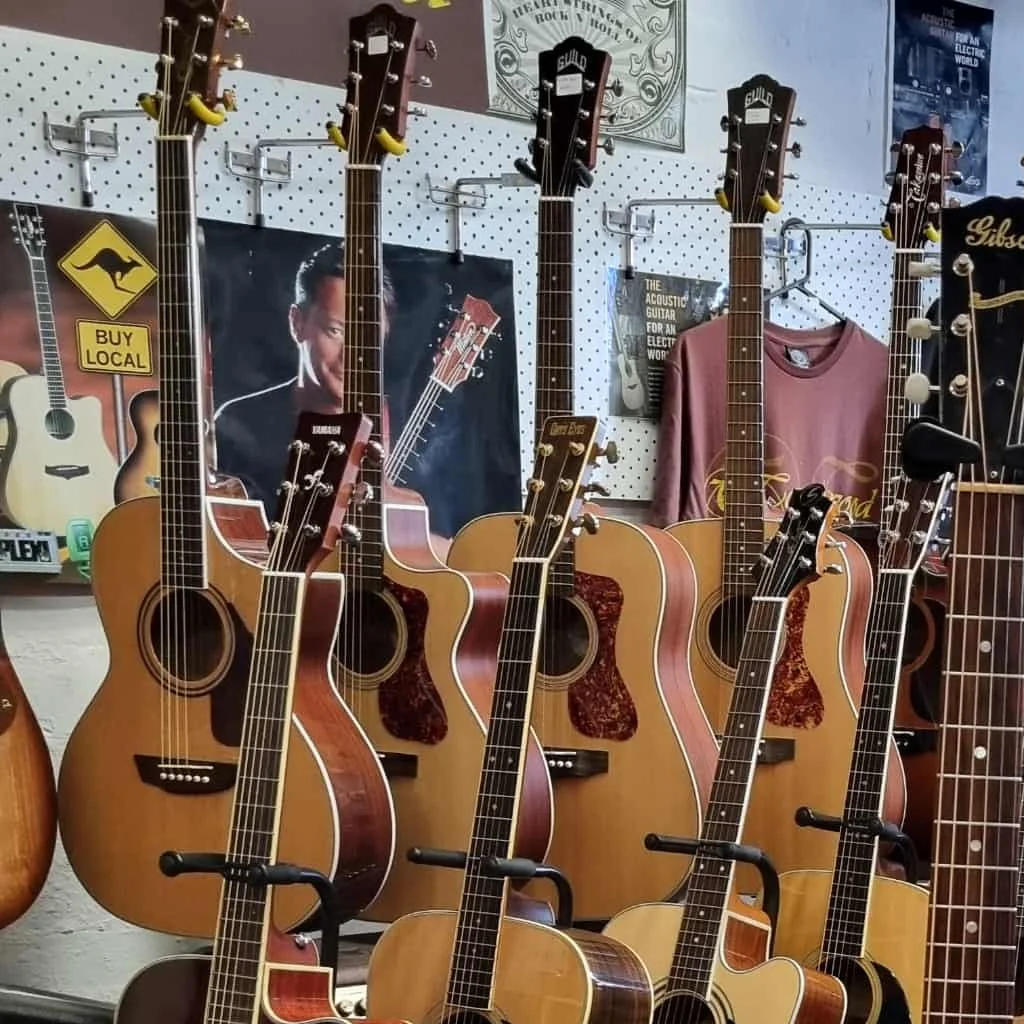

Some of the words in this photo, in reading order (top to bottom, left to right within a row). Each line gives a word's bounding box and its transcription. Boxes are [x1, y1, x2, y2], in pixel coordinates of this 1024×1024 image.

[954, 43, 986, 59] ELECTRIC
[557, 49, 588, 73] GUILD
[954, 54, 979, 68] WORLD
[744, 86, 773, 109] GUILD
[645, 279, 661, 291] THE
[645, 293, 688, 308] ACOUSTIC
[646, 307, 676, 321] GUITAR
[646, 322, 663, 334] FOR
[665, 324, 677, 335] AN
[95, 329, 133, 346] BUY
[86, 349, 147, 369] LOCAL
